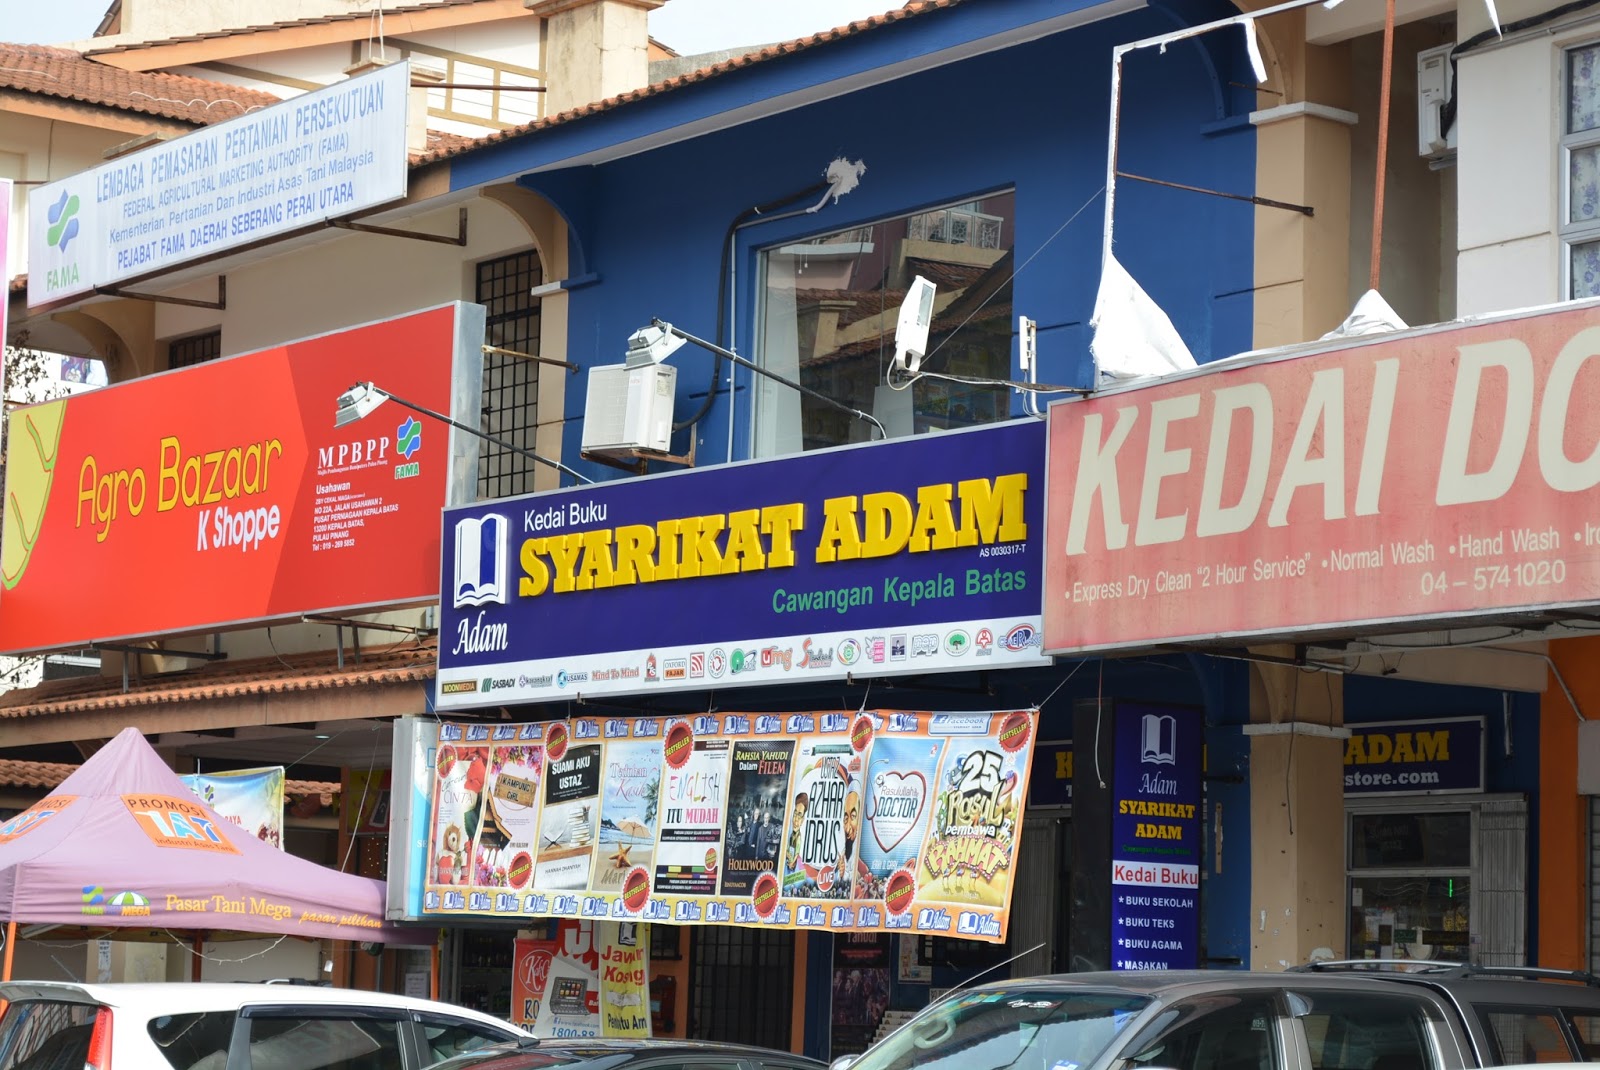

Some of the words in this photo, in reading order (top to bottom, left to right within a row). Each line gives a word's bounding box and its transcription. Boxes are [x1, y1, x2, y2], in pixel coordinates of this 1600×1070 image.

[96, 162, 144, 203] LEMBAGA
[151, 135, 218, 185] PEMASARAN
[225, 113, 289, 161] PERTANIAN
[295, 80, 384, 138] PERSEKUTUAN
[123, 195, 156, 219] FEDERAL
[159, 178, 216, 208] AGRICULTURAL
[219, 158, 264, 189] MARKETING
[267, 142, 314, 172] AUTHORITY
[318, 132, 349, 161] (FAMA)
[109, 217, 165, 244] Kementerian
[169, 201, 214, 226] Pertanian
[216, 195, 235, 212] Dan
[238, 179, 275, 205] Industri
[277, 173, 303, 193] Asas
[306, 167, 326, 184] Tani
[328, 150, 374, 175] Malaysia
[117, 241, 157, 270] PEJABAT
[160, 232, 185, 257] FAMA
[190, 219, 228, 249] DAERAH
[231, 203, 283, 236] SEBERANG
[286, 192, 316, 220] PERAI
[319, 181, 354, 210] UTARA
[46, 262, 80, 293] FAMA
[317, 436, 390, 470] MPBPP
[1065, 357, 1400, 556] KEDAI
[394, 461, 420, 480] FAMA
[75, 454, 147, 544] Agro
[156, 435, 283, 513] Bazaar
[315, 482, 351, 495] Usahawan
[313, 514, 330, 524] PUSAT
[330, 510, 363, 522] PERNIAGAAN
[363, 507, 383, 517] KEPALA
[383, 504, 399, 513] BATAS
[314, 507, 322, 515] NO
[334, 502, 350, 512] JALAN
[351, 498, 378, 509] USAHAWAN
[328, 520, 347, 531] KEPALA
[524, 504, 565, 533] Kedai
[569, 500, 607, 526] Buku
[196, 509, 211, 552] K
[213, 504, 281, 553] Shoppe
[312, 532, 329, 542] PULAU
[330, 530, 349, 540] PINANG
[519, 502, 804, 598] SYARIKAT
[816, 472, 1028, 564] ADAM
[979, 547, 990, 558] AS
[990, 543, 1026, 557] 0030317-T
[1073, 581, 1122, 606] Express
[1127, 574, 1150, 599] Dry
[1155, 570, 1192, 593] Clean
[1216, 562, 1247, 586] Hour
[1330, 544, 1384, 572] Normal
[1391, 539, 1435, 565] Wash
[1459, 530, 1503, 558] Hand
[1511, 525, 1560, 553] Wash
[1421, 570, 1448, 596] 04
[1474, 559, 1566, 591] 5741020
[772, 585, 873, 614] Cawangan
[883, 572, 955, 606] Kepala
[965, 567, 1026, 596] Batas
[452, 610, 508, 656] Adam
[592, 670, 610, 681] Mind
[611, 668, 620, 679] To
[621, 666, 640, 678] Mind
[664, 660, 686, 669] OXFORD
[665, 669, 685, 678] FAJAR
[443, 681, 476, 693] MOONMEDIA
[491, 677, 516, 689] SASBADI
[735, 751, 760, 761] RAHSIA
[761, 750, 789, 760] YAHUDI
[1343, 730, 1450, 765] ADAM
[551, 759, 574, 775] SUAMI
[576, 756, 591, 769] AKU
[610, 763, 647, 778] Teduhan
[739, 762, 758, 771] Dalam
[757, 761, 786, 775] FILEM
[958, 750, 1004, 793] 25
[502, 777, 530, 793] KAMPUNG
[559, 774, 582, 790] USTAZ
[1138, 771, 1178, 795] Adam
[1343, 770, 1439, 786] store.com
[128, 799, 206, 818] PROMOSI
[806, 782, 844, 819] AZHAR
[876, 796, 918, 819] DOCTOR
[1119, 799, 1196, 819] SYARIKAT
[666, 808, 683, 824] ITU
[685, 808, 719, 824] MUDAH
[1135, 823, 1183, 840] ADAM
[155, 837, 192, 847] Industri
[802, 819, 841, 864] IDRUS
[728, 858, 774, 872] HOLLYWOOD
[927, 836, 1009, 875] RAHMAT
[818, 871, 834, 885] LIVE
[1114, 864, 1157, 883] Kedai
[1161, 867, 1198, 885] Buku
[121, 905, 151, 917] MEGA
[1125, 895, 1151, 906] BUKU
[1152, 897, 1193, 908] SEKOLAH
[165, 895, 209, 912] Pasar
[211, 895, 246, 914] Tani
[249, 897, 292, 921] Mega
[299, 911, 337, 925] pasar
[337, 913, 383, 929] pilihan
[1125, 917, 1150, 928] BUKU
[1152, 918, 1175, 929] TEKS
[1124, 938, 1150, 949] BUKU
[1151, 940, 1183, 950] AGAMA
[1124, 960, 1168, 970] MASAKAN
